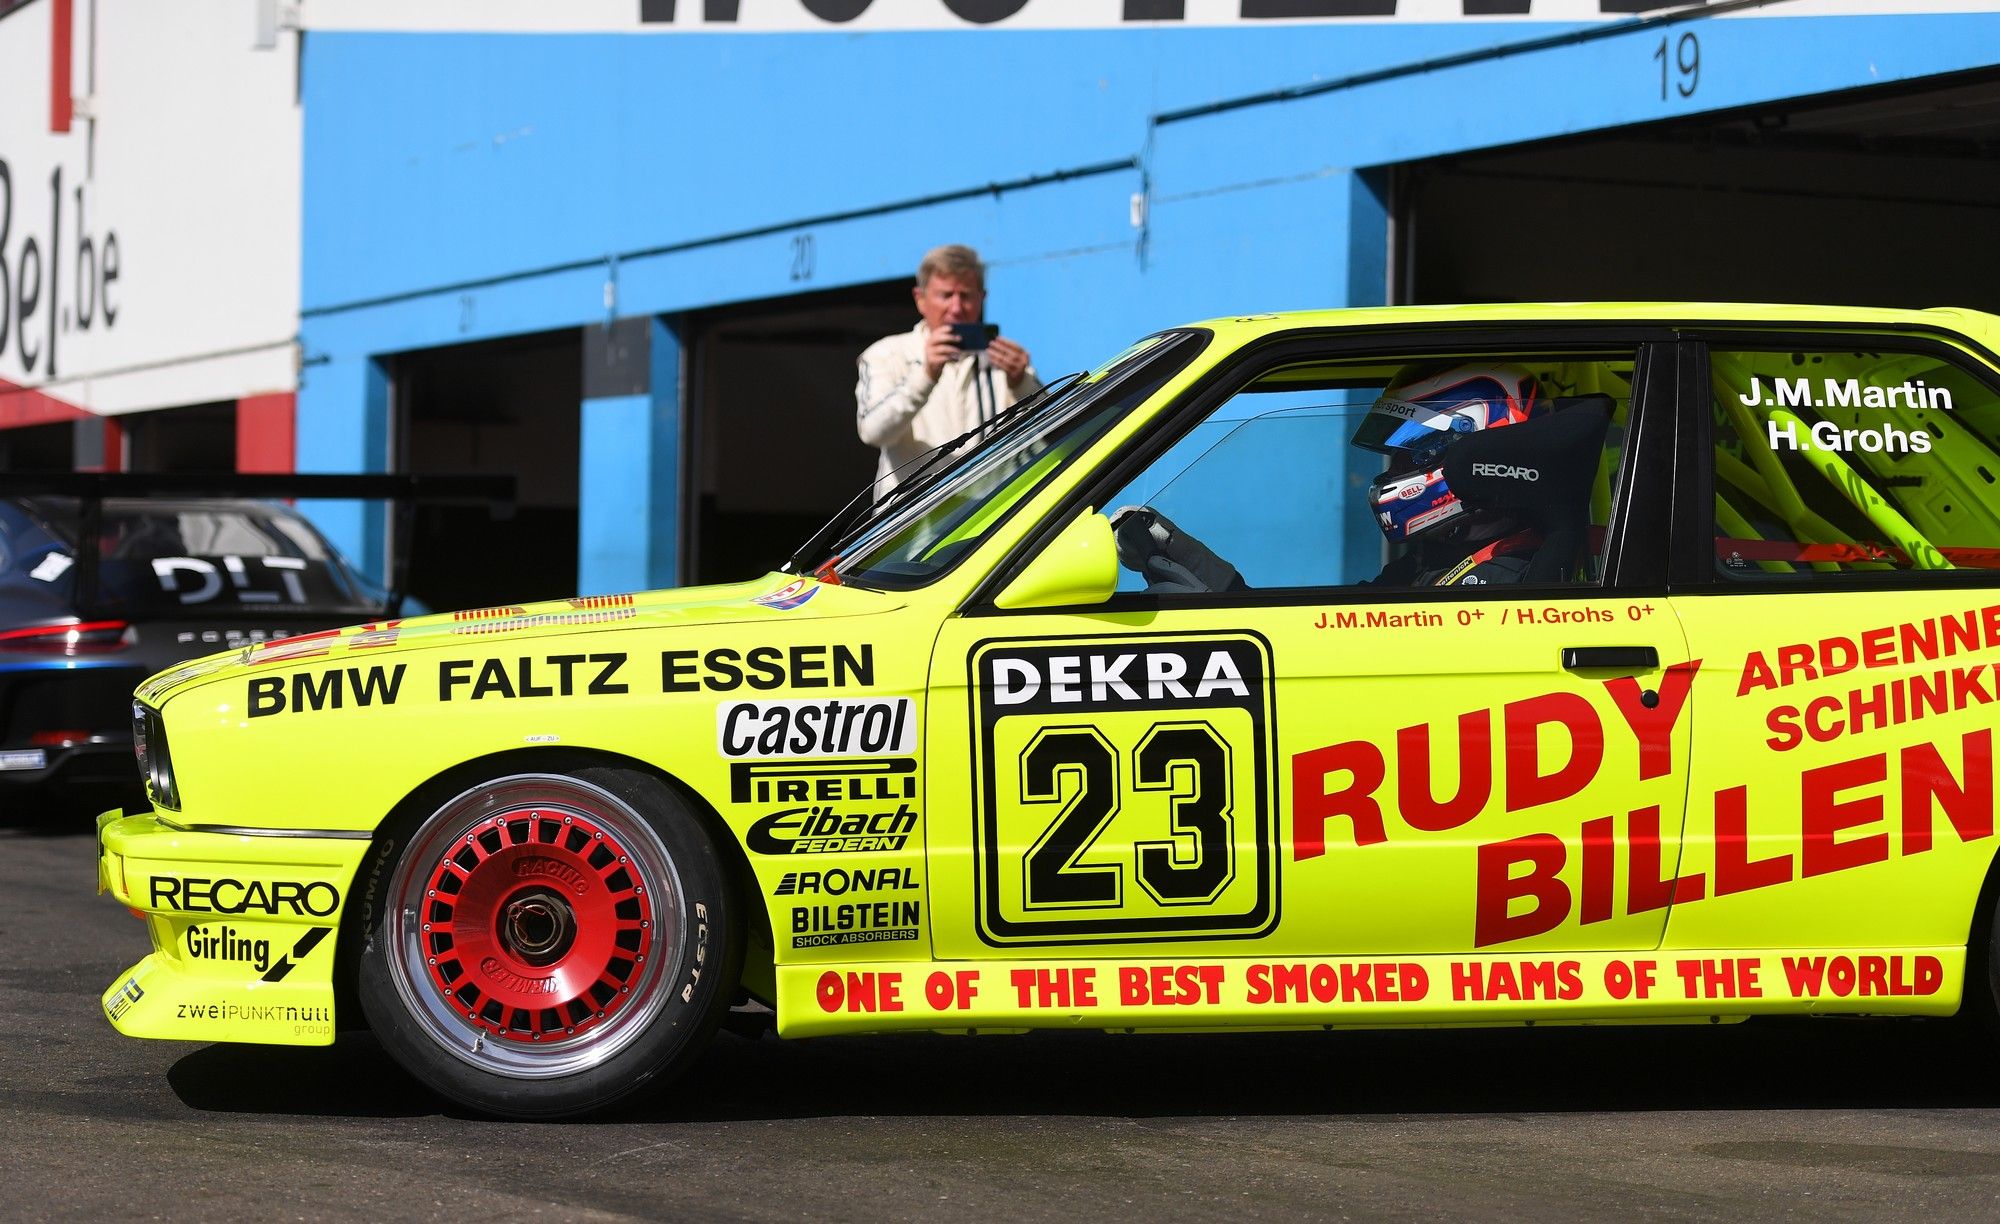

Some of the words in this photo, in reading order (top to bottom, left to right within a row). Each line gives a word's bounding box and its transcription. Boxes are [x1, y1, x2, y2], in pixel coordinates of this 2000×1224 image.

[1653, 31, 1700, 101] 19
[1739, 377, 1953, 410] J.M.Martin
[1767, 420, 1932, 454] H.Grohs
[1401, 485, 1422, 498] BELL
[1472, 463, 1540, 482] RECARO
[1314, 610, 1443, 629] J.M.Martin
[1456, 608, 1485, 627] 0+
[1516, 606, 1615, 625] H.Grohs
[1627, 604, 1655, 622] 0+
[247, 663, 407, 719] BMW
[439, 652, 629, 702] FALTZ
[661, 644, 874, 693] ESSEN
[991, 650, 1251, 706] DEKRA
[722, 698, 908, 757] Castrol
[1765, 663, 2000, 752] SCHINK
[730, 757, 918, 804] PIRELLI
[1291, 658, 1704, 863] RUDY
[745, 803, 918, 855] Eibach
[1018, 719, 1239, 913] 23
[1473, 727, 1994, 949] BILLEN
[790, 836, 900, 854] FEDERN
[149, 875, 341, 917] RECARO
[517, 858, 590, 897] RACING
[797, 867, 920, 897] RONAL
[791, 900, 920, 934] BILSTEIN
[795, 932, 838, 948] SHOCK
[840, 929, 916, 944] ABSORBERS
[186, 924, 270, 972] Girling
[815, 970, 904, 1014] ONE
[924, 969, 981, 1012] OF
[1010, 967, 1099, 1009] THE
[1118, 964, 1226, 1007] BEST
[1245, 962, 1430, 1005] SMOKED
[1450, 959, 1584, 1002] HAMS
[1603, 959, 1658, 1001] OF
[1676, 957, 1763, 999] THE
[1781, 955, 1944, 998] WORLD
[293, 1024, 331, 1037] group
